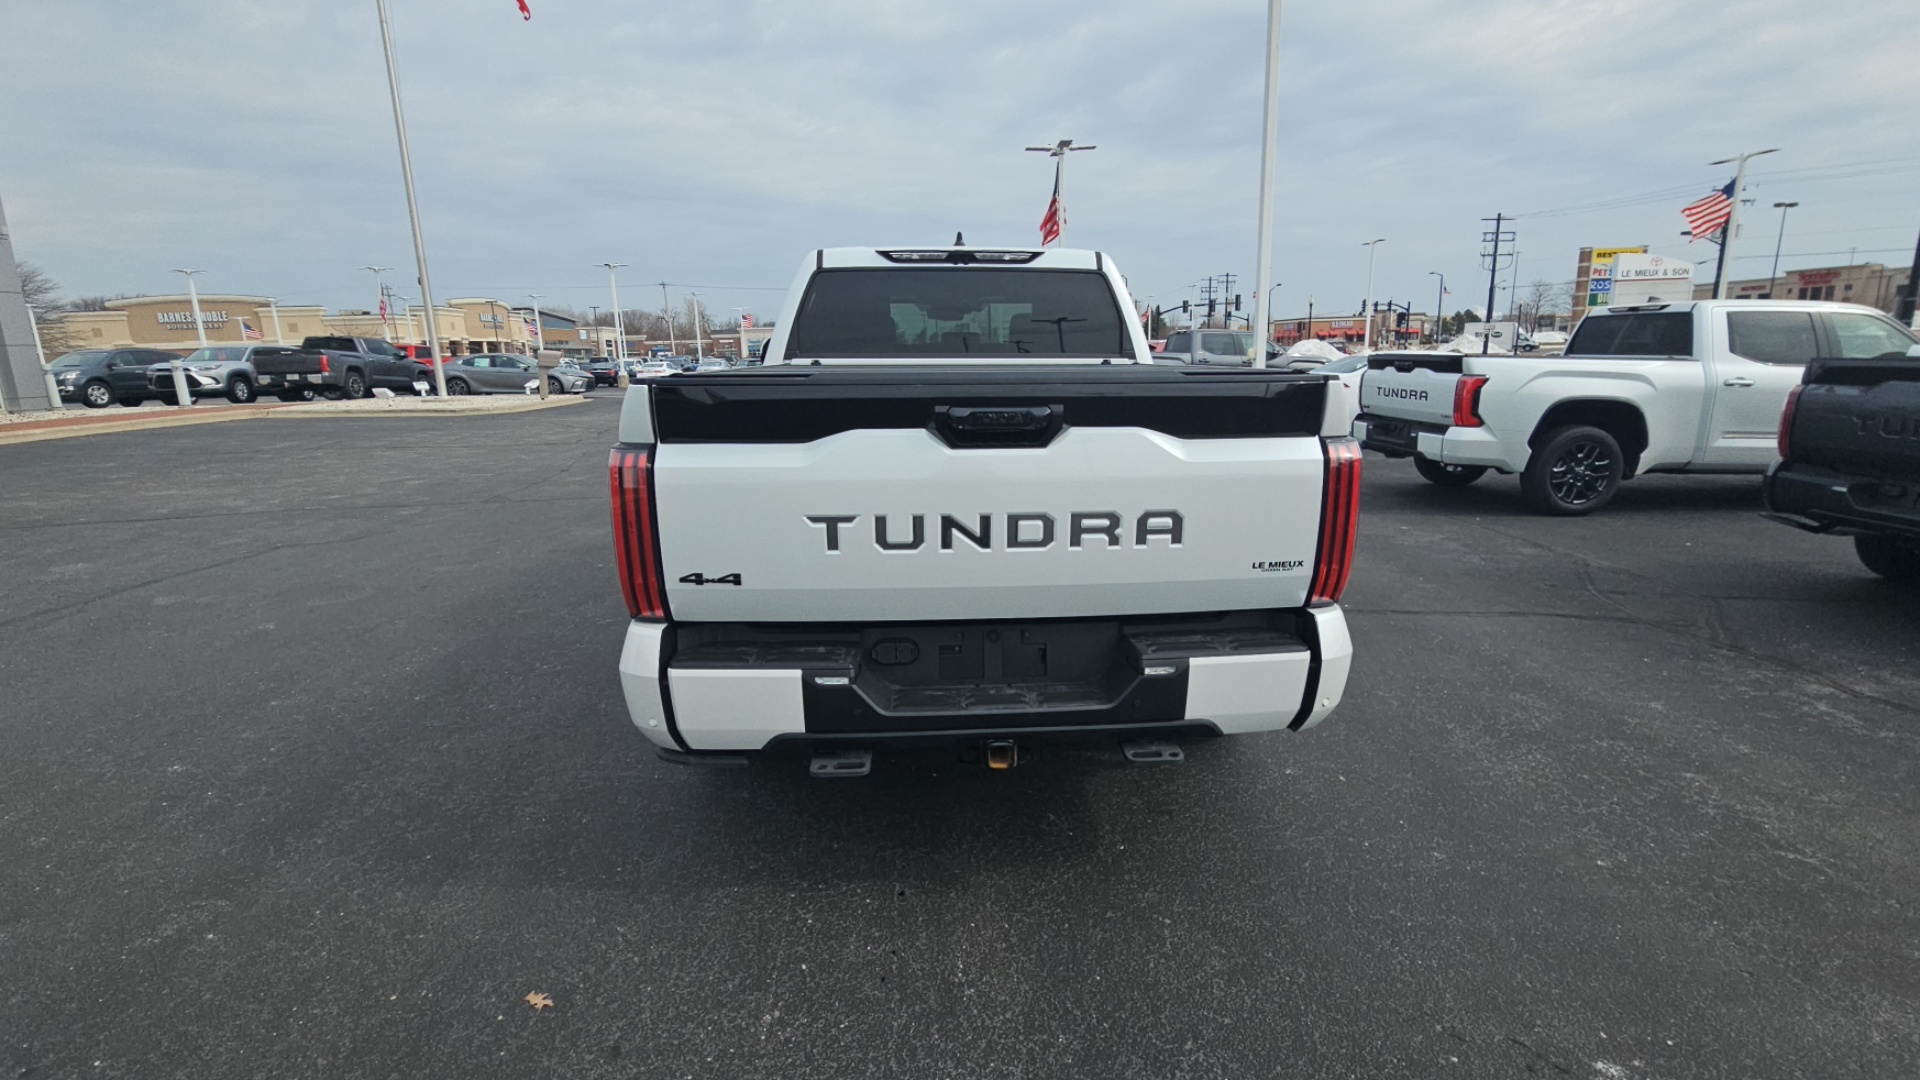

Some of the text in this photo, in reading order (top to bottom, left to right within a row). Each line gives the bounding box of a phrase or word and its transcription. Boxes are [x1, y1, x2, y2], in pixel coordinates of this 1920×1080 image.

[1634, 269, 1659, 277] MIEUX
[1662, 268, 1668, 276] &
[1672, 268, 1690, 276] SON
[157, 312, 192, 323] BARNES
[199, 311, 228, 322] NOBLE
[166, 323, 224, 331] BOOKSELERS
[1376, 386, 1429, 401] TUNDRA
[802, 509, 1185, 555] TUNDRA
[1252, 560, 1305, 570] LE MIEUX
[679, 572, 742, 586] 4x4
